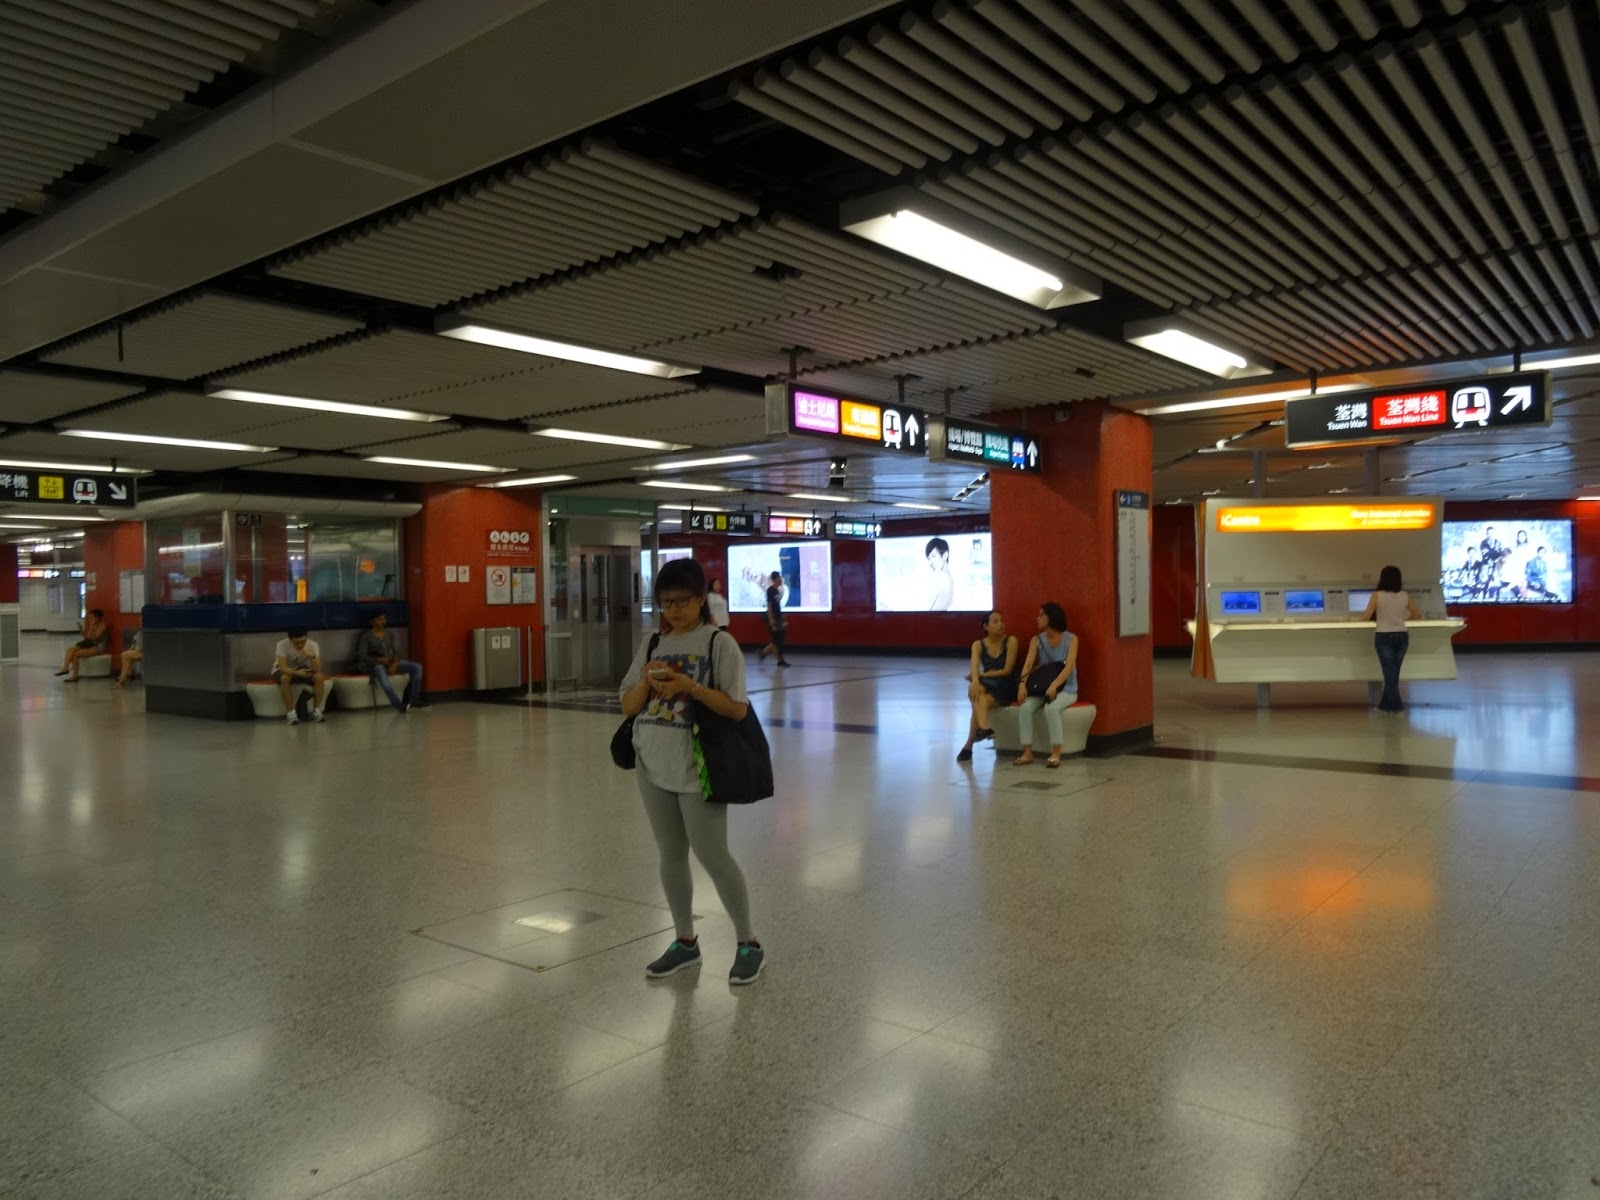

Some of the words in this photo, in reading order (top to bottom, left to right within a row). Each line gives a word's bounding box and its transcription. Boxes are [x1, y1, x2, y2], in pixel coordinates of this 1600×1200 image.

[1379, 416, 1402, 426] Tsuen
[1403, 415, 1421, 424] Wan
[1421, 413, 1439, 422] Line
[1327, 421, 1350, 431] Tsuen
[1350, 420, 1368, 429] Wan
[15, 490, 29, 498] Lift
